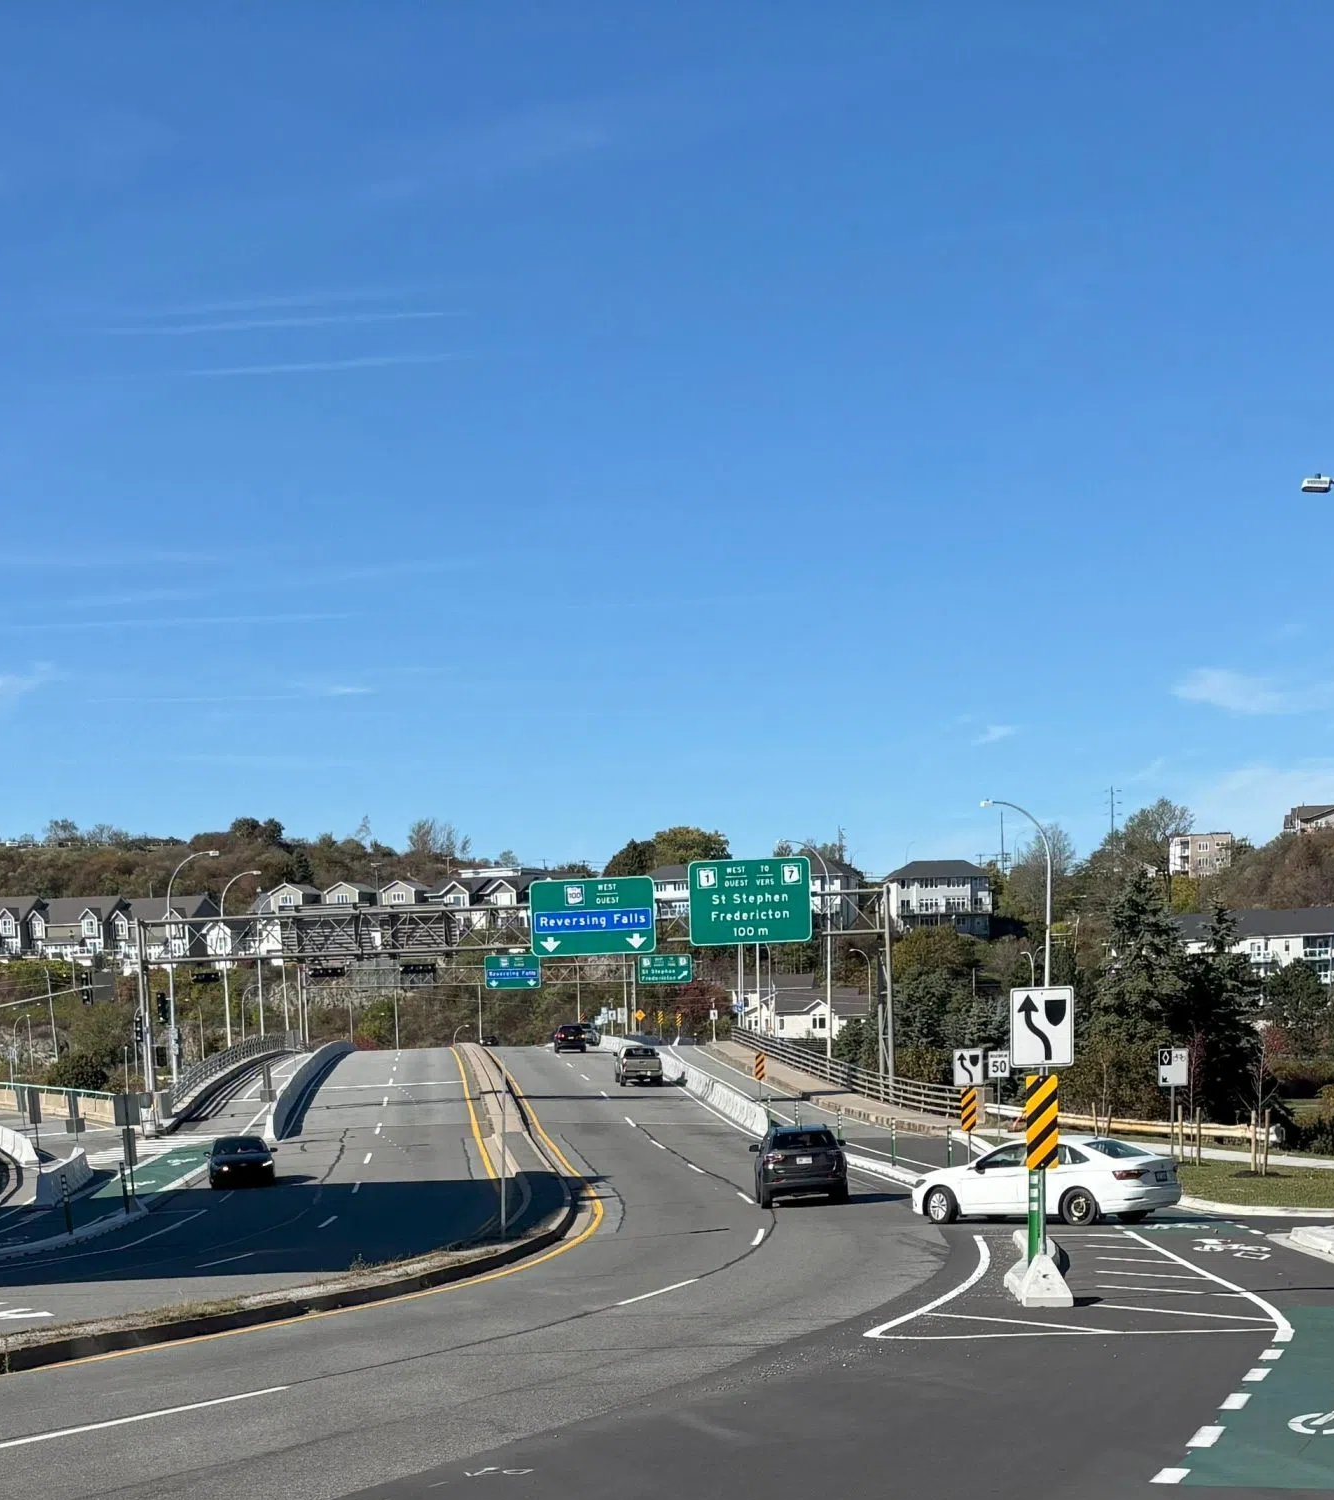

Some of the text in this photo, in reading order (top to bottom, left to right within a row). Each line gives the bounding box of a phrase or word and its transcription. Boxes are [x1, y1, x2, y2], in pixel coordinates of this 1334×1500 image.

[705, 874, 710, 884] 1
[788, 870, 794, 880] 7
[711, 892, 788, 905] St Stephen
[539, 912, 646, 928] Reversing Falls
[711, 909, 790, 922] Fredericton
[733, 926, 769, 937] 100 m
[992, 1060, 1007, 1073] 50
